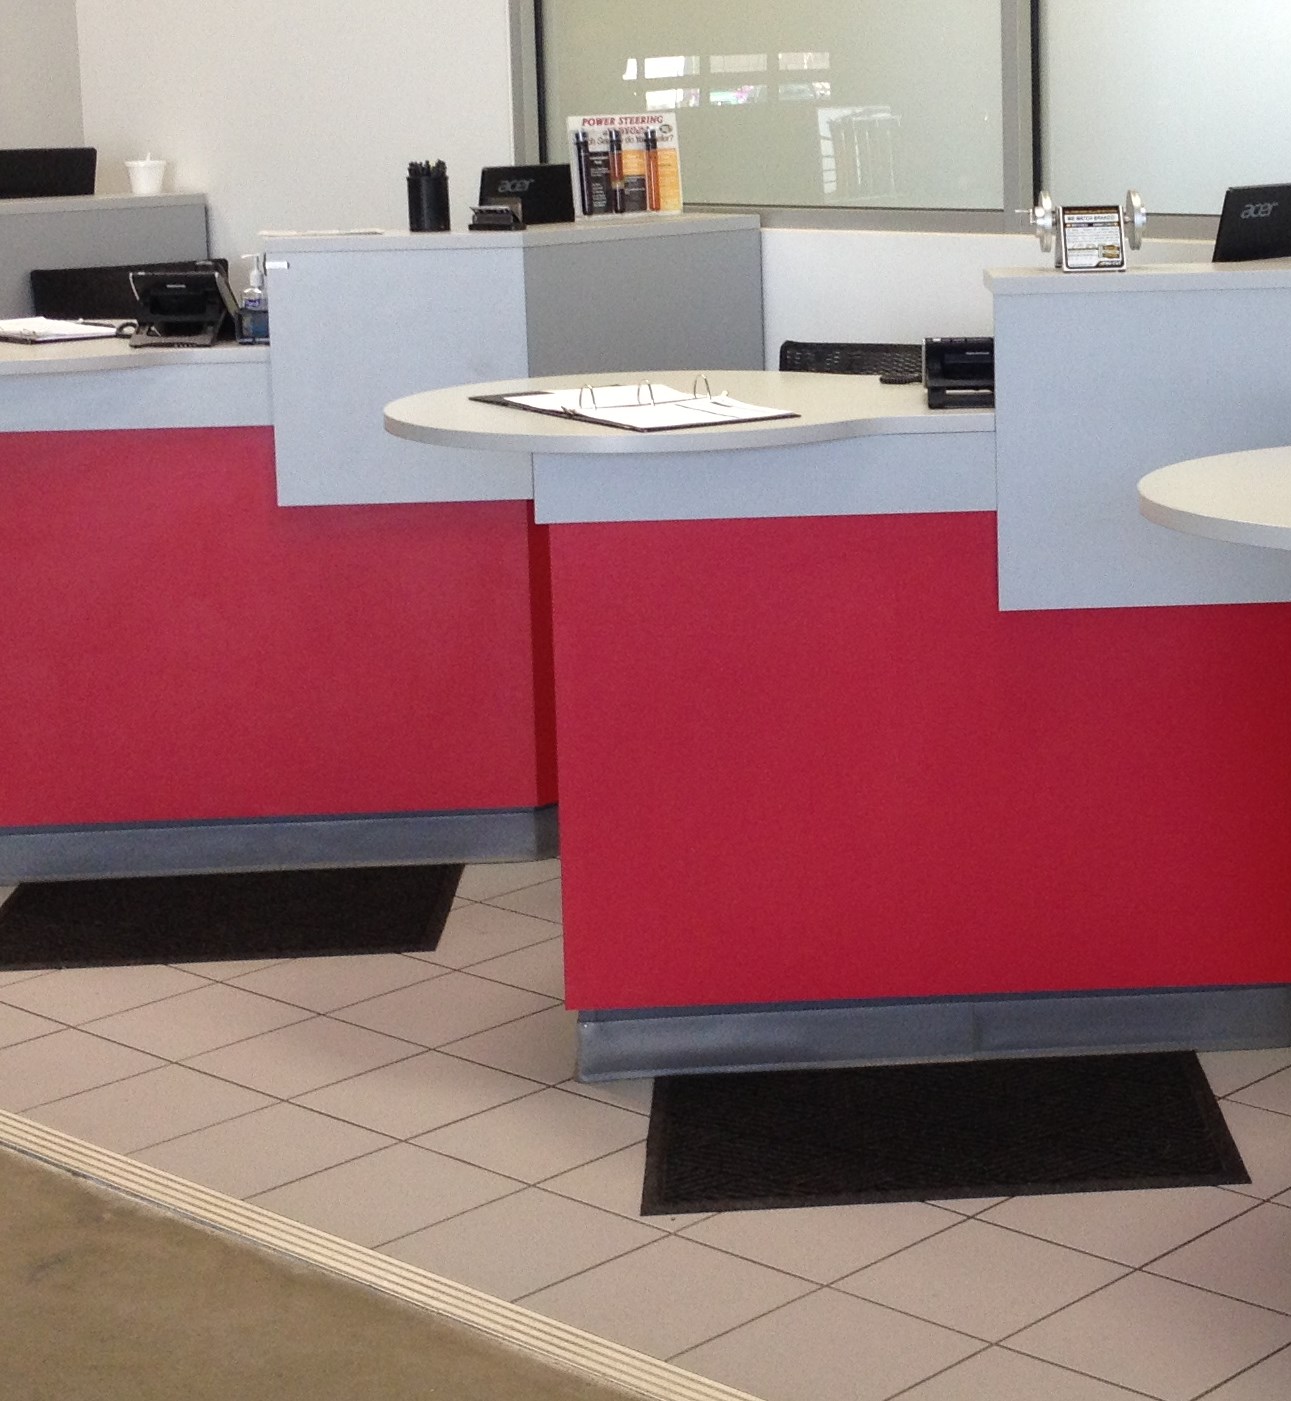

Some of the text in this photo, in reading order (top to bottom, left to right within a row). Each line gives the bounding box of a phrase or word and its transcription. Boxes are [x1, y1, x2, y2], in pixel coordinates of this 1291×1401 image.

[582, 115, 664, 127] POWER STEERING
[498, 179, 535, 193] acer
[1240, 201, 1279, 219] acer
